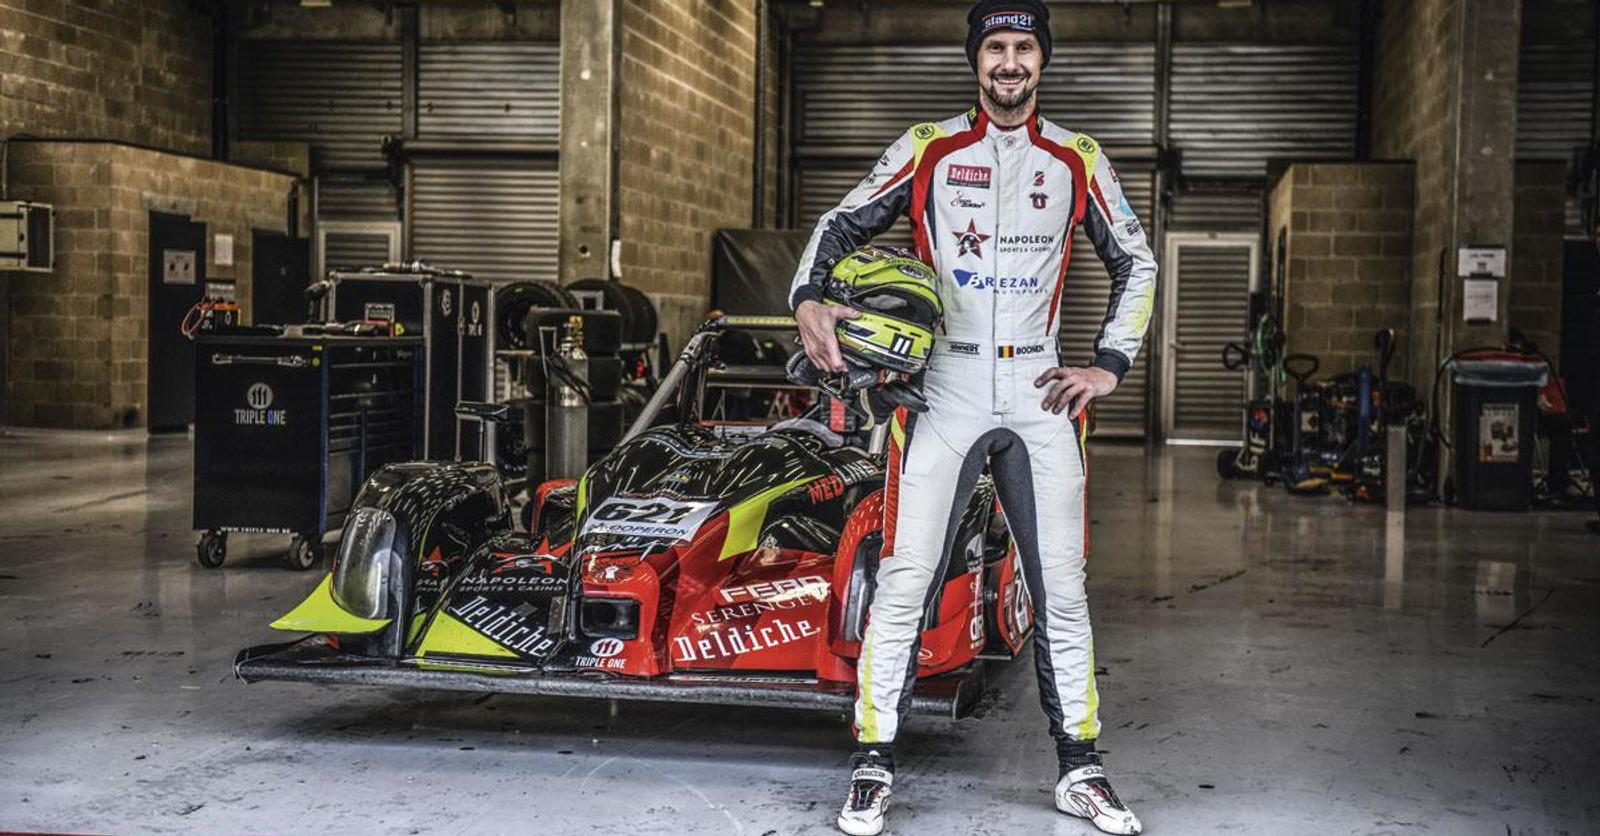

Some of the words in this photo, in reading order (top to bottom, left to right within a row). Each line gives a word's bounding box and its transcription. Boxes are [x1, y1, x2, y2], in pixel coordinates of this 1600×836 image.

[985, 14, 1032, 28] stand21
[1000, 235, 1054, 244] NAPOLEON
[1016, 345, 1045, 355] BOONEN
[235, 409, 265, 424] TRIPLE
[268, 410, 286, 425] ONE
[461, 576, 569, 584] NAPOLEON
[450, 595, 553, 657] Deldiche
[674, 619, 821, 661] Deldiche
[576, 656, 606, 668] TRIPLE
[607, 658, 626, 669] ONE
